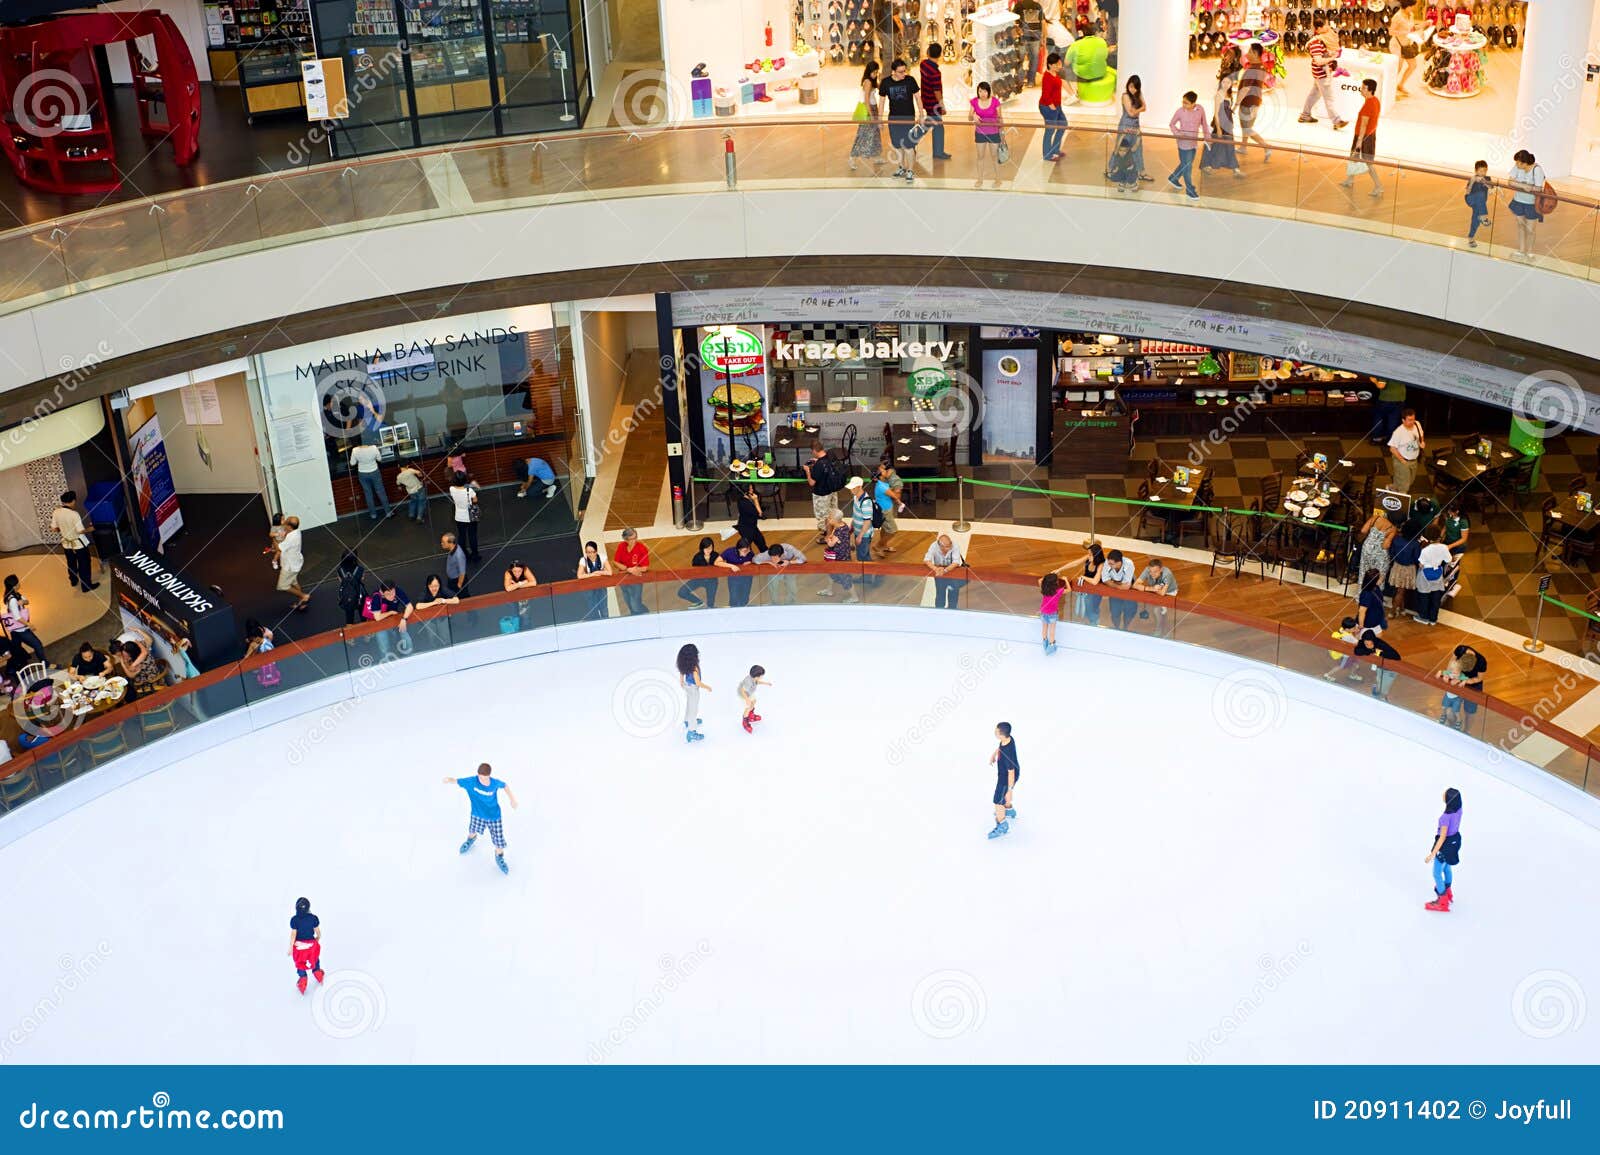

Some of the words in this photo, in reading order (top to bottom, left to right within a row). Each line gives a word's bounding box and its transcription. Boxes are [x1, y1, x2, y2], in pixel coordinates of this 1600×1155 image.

[800, 297, 818, 306] FOR
[821, 297, 860, 308] HEALTH
[914, 310, 953, 320] HEALTH
[296, 347, 388, 380] MARINA
[394, 338, 437, 360] BAY
[445, 325, 519, 352] SANDS
[724, 357, 742, 365] TAKE
[776, 339, 853, 360] kraze
[859, 338, 955, 362] bakery
[335, 364, 430, 393] SKATING
[438, 353, 487, 378] RINK
[125, 550, 164, 576] RINK
[155, 572, 213, 613] SKATING
